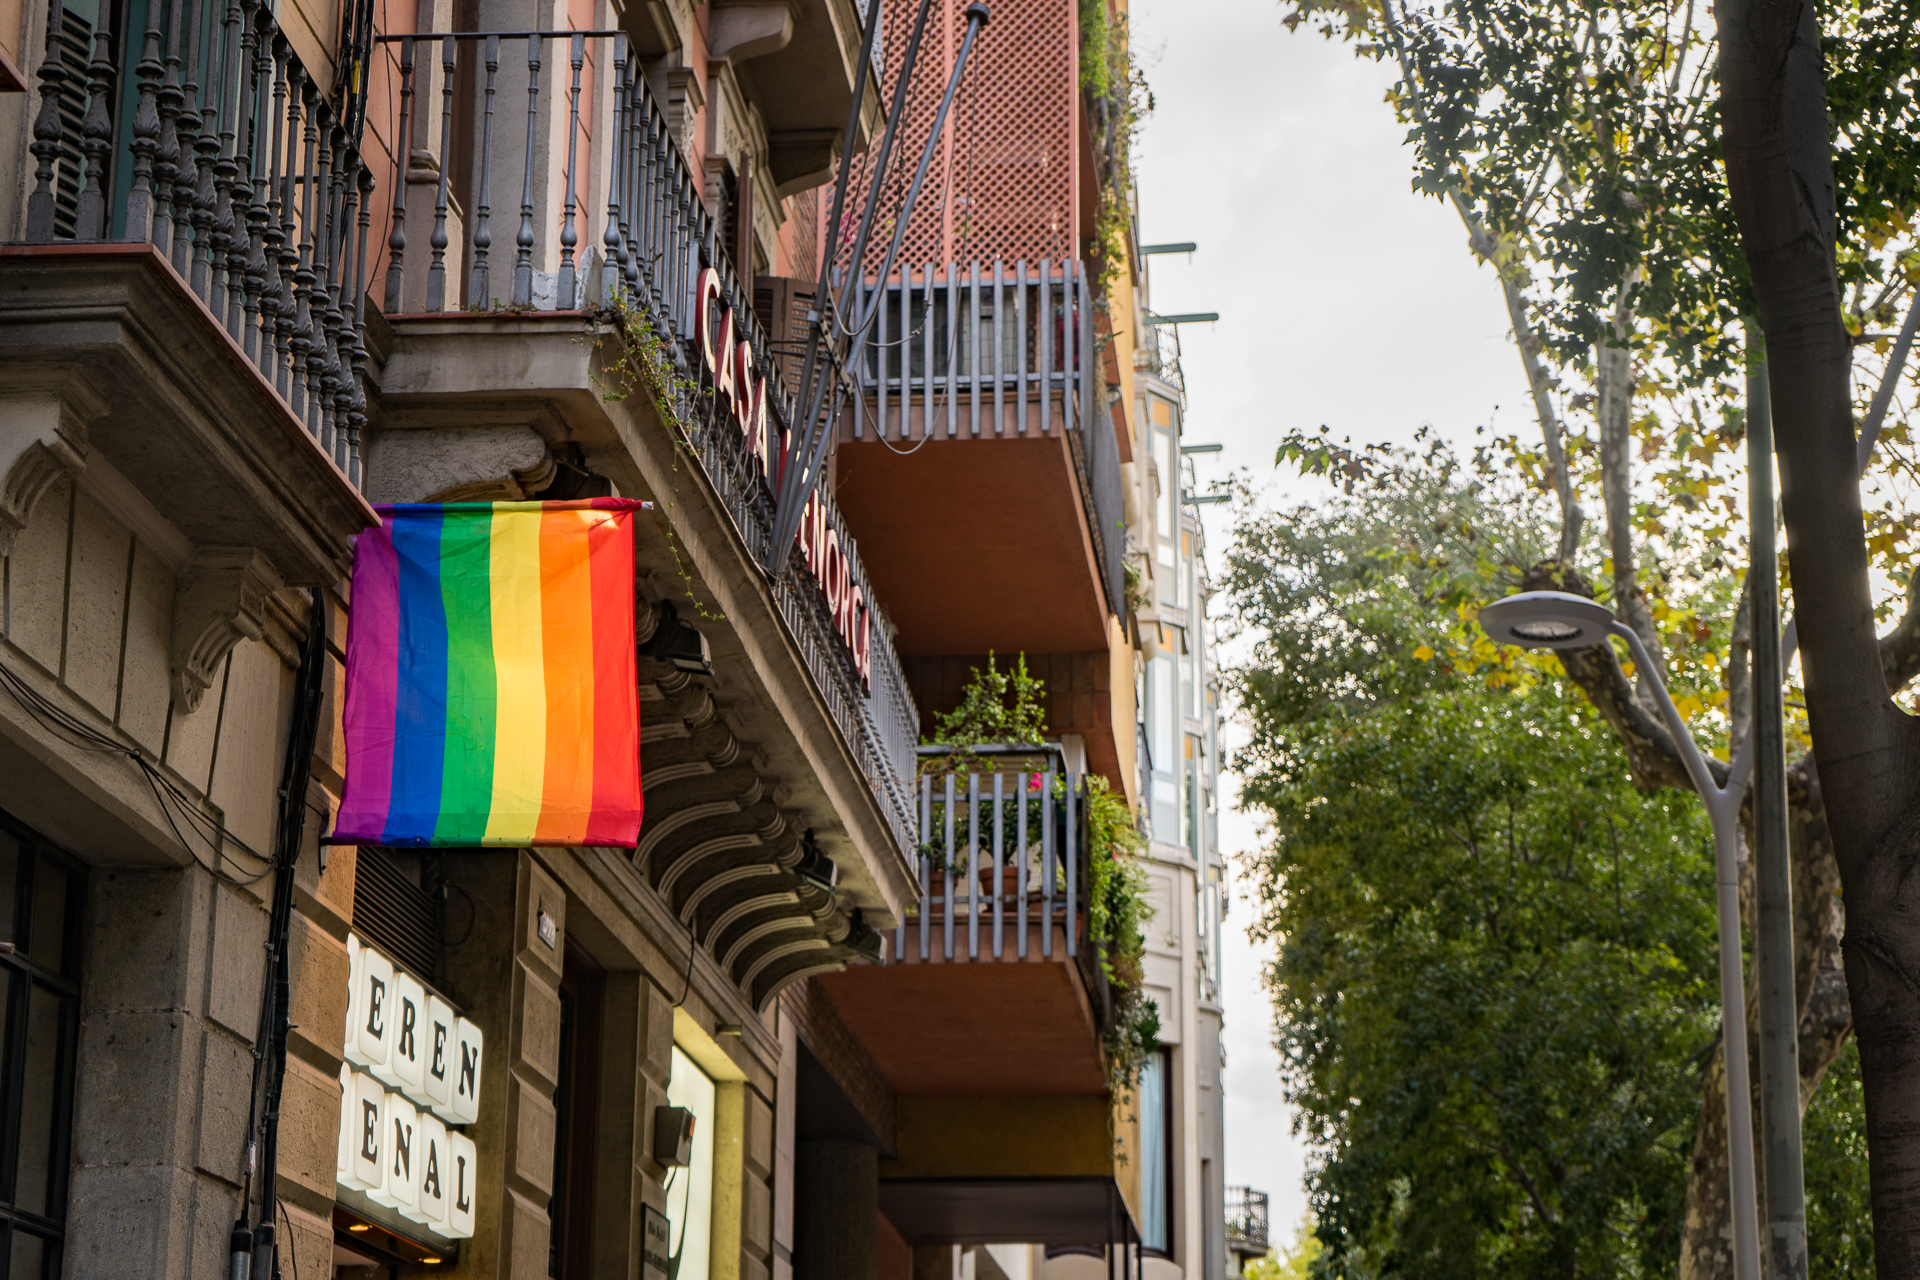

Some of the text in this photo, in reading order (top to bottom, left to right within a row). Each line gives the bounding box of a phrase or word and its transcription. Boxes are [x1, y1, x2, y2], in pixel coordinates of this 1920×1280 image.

[696, 267, 871, 692] CASA ENORCA
[348, 962, 478, 1102] EREN
[341, 1082, 472, 1215] ENAL
